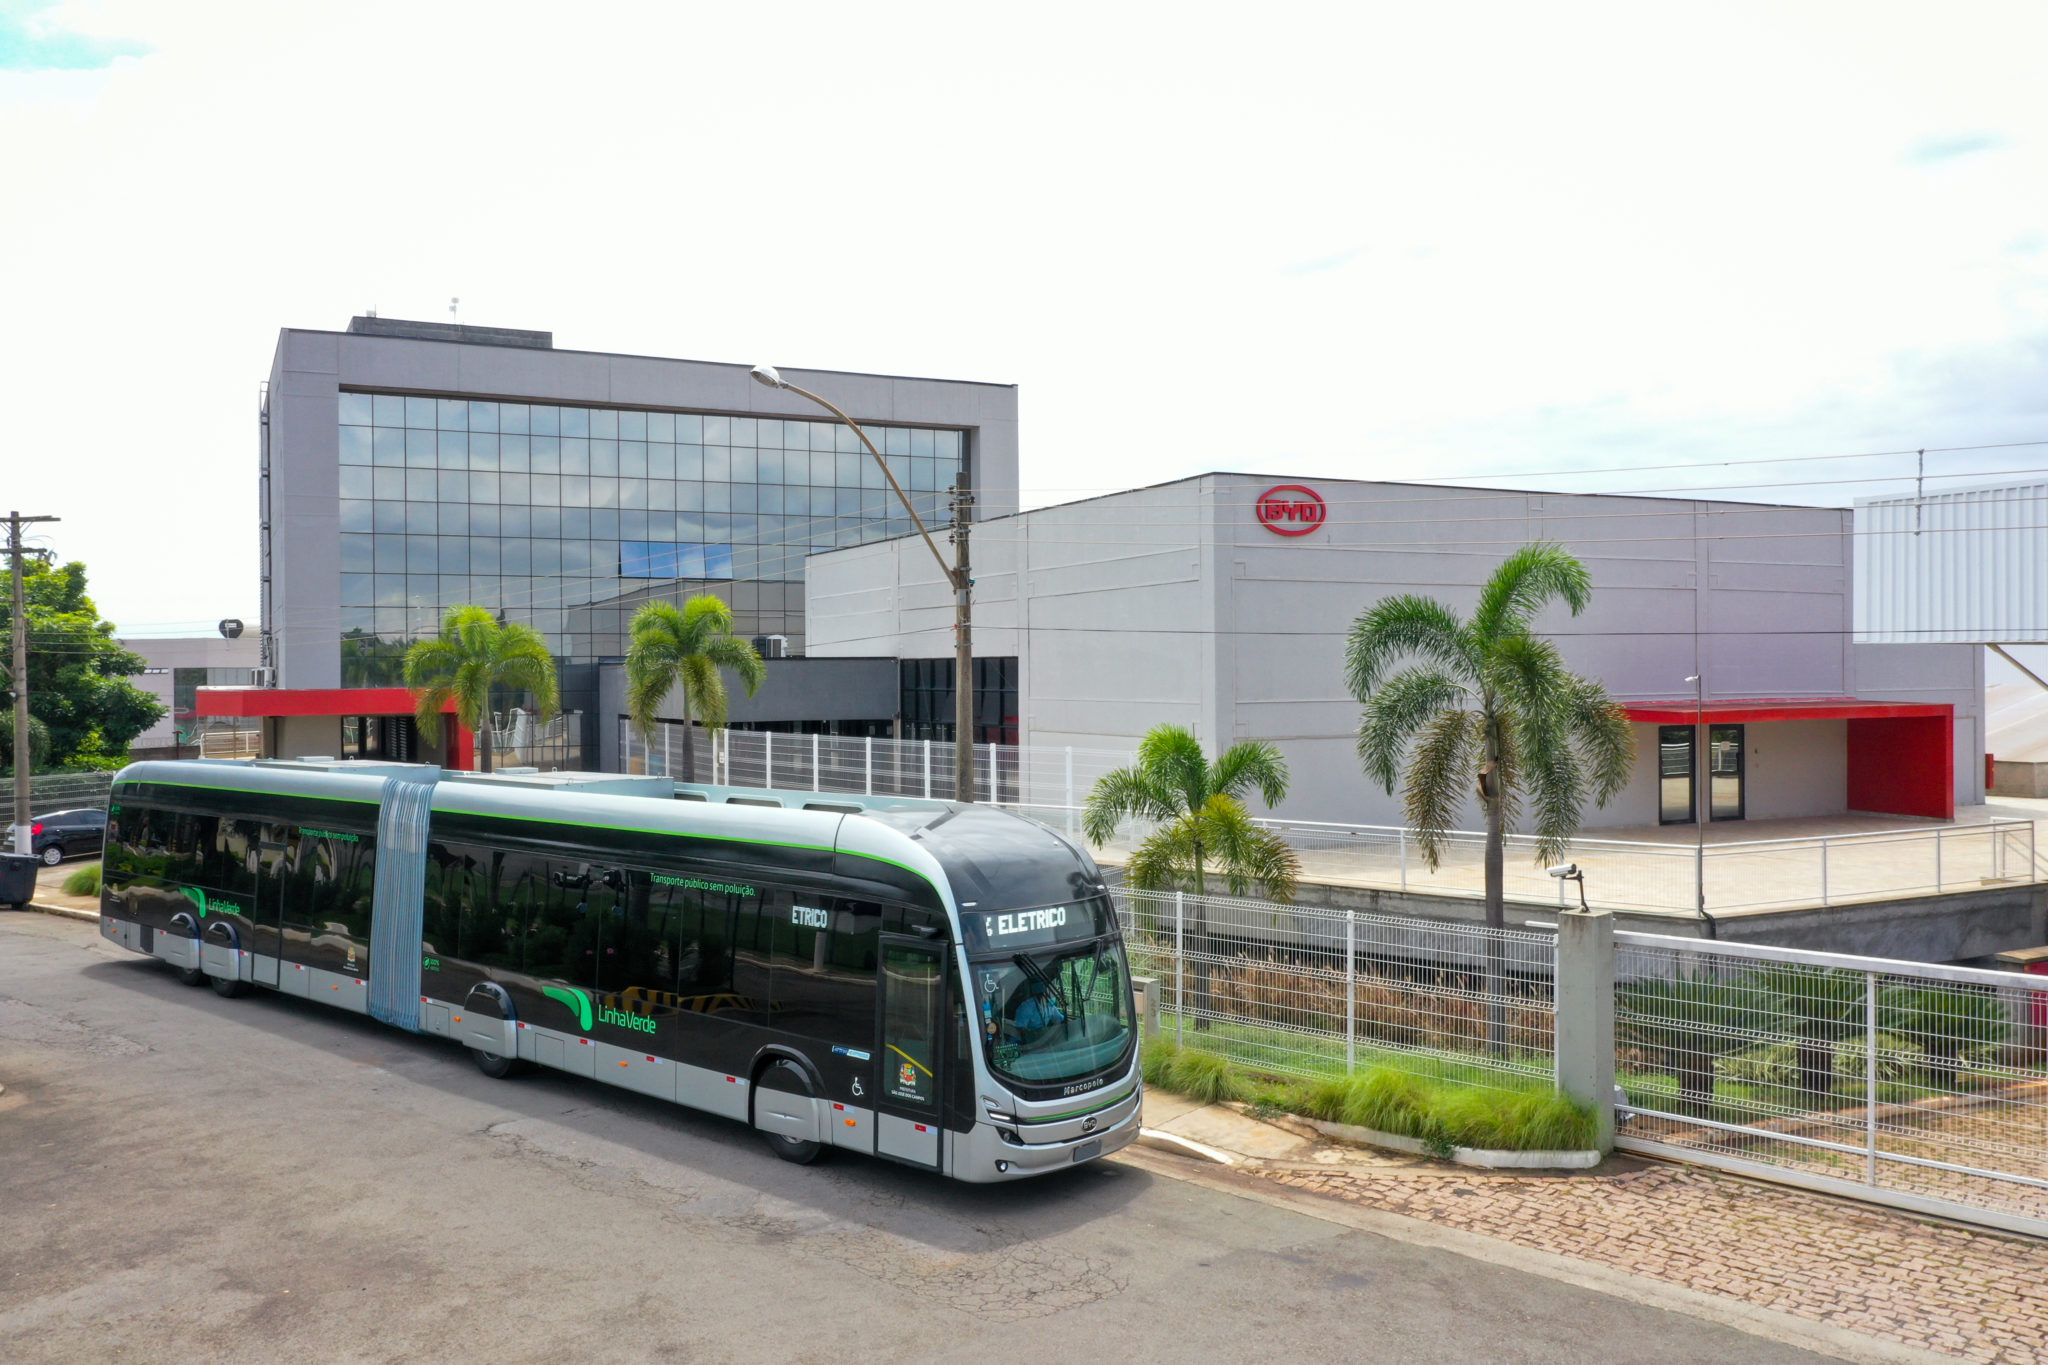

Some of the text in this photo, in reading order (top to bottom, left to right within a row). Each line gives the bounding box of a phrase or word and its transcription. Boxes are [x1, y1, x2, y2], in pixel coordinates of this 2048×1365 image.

[1264, 499, 1318, 522] BYD
[650, 872, 756, 897] Transporte público sem poluição.
[792, 905, 828, 928] ETRICO
[998, 907, 1066, 935] ELETRICO
[599, 1004, 656, 1034] LinhaVerde
[1063, 1078, 1104, 1096] Marcopolo
